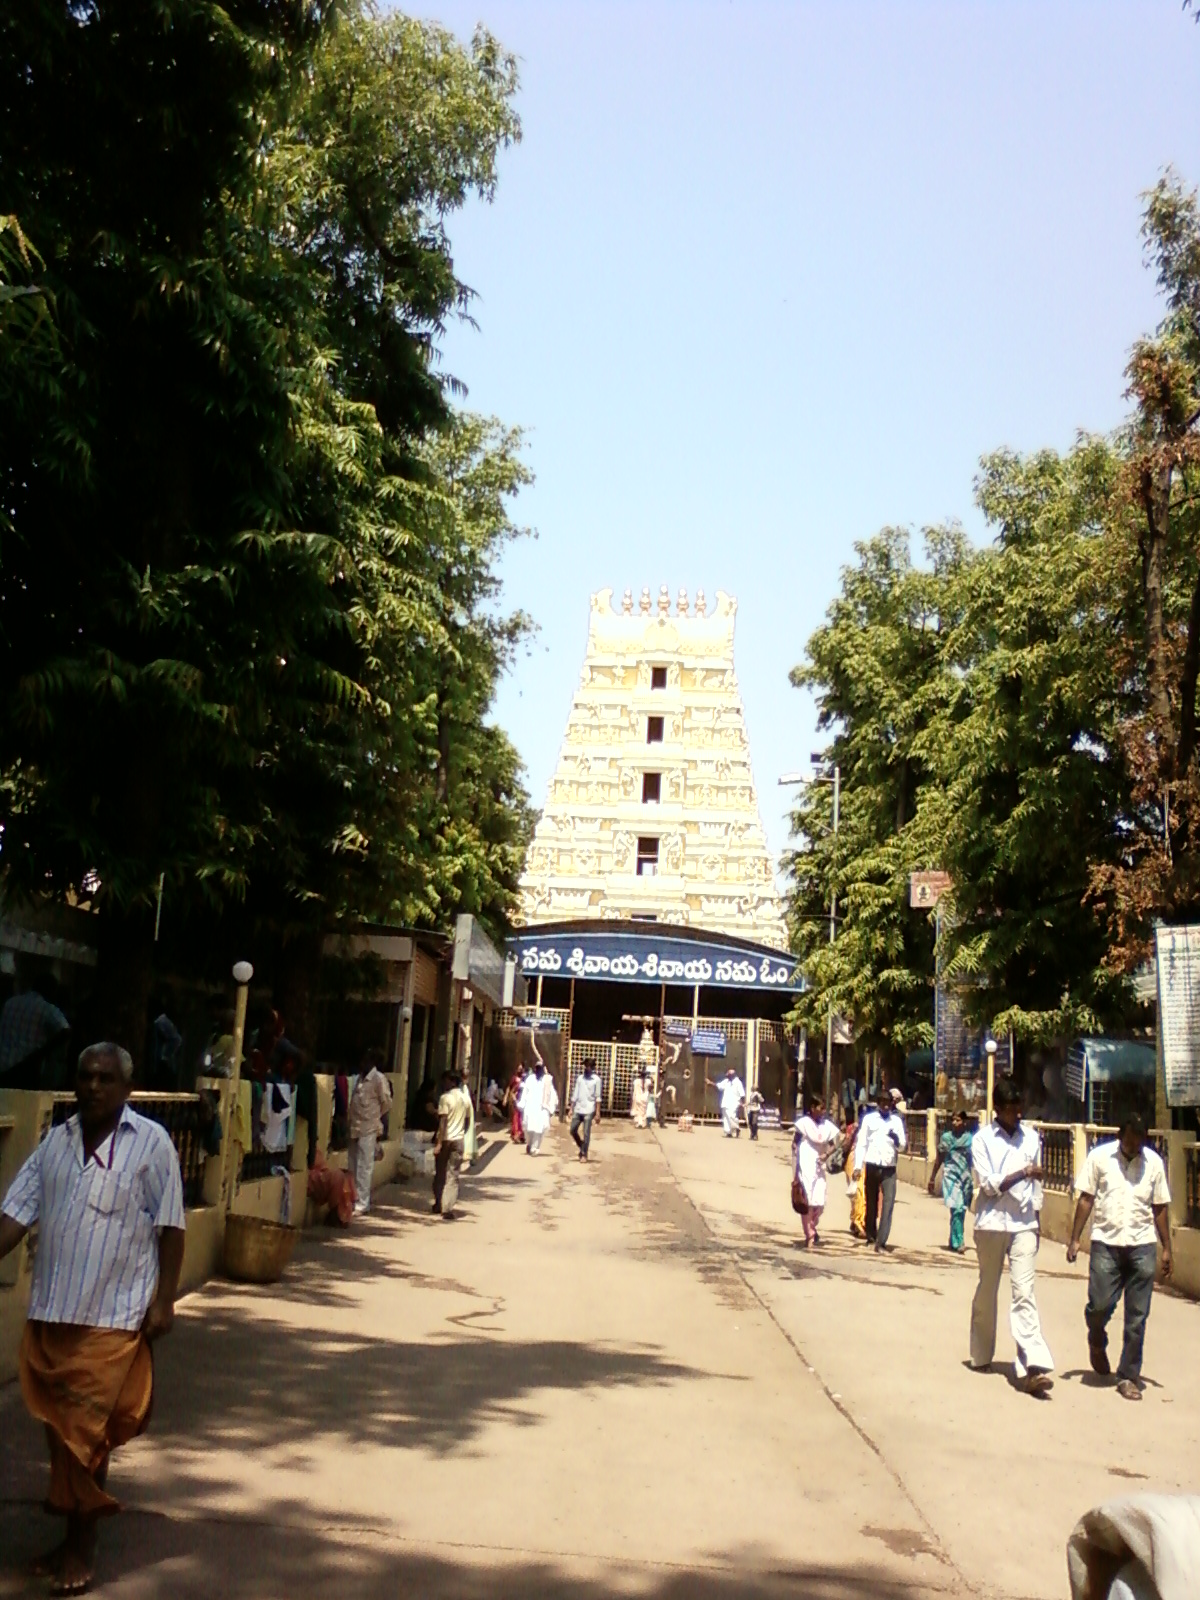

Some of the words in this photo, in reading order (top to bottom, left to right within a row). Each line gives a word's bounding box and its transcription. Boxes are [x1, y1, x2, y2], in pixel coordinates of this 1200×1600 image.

[522, 946, 562, 971] నమ
[715, 959, 757, 983] నమ
[759, 958, 788, 984] ఓం
